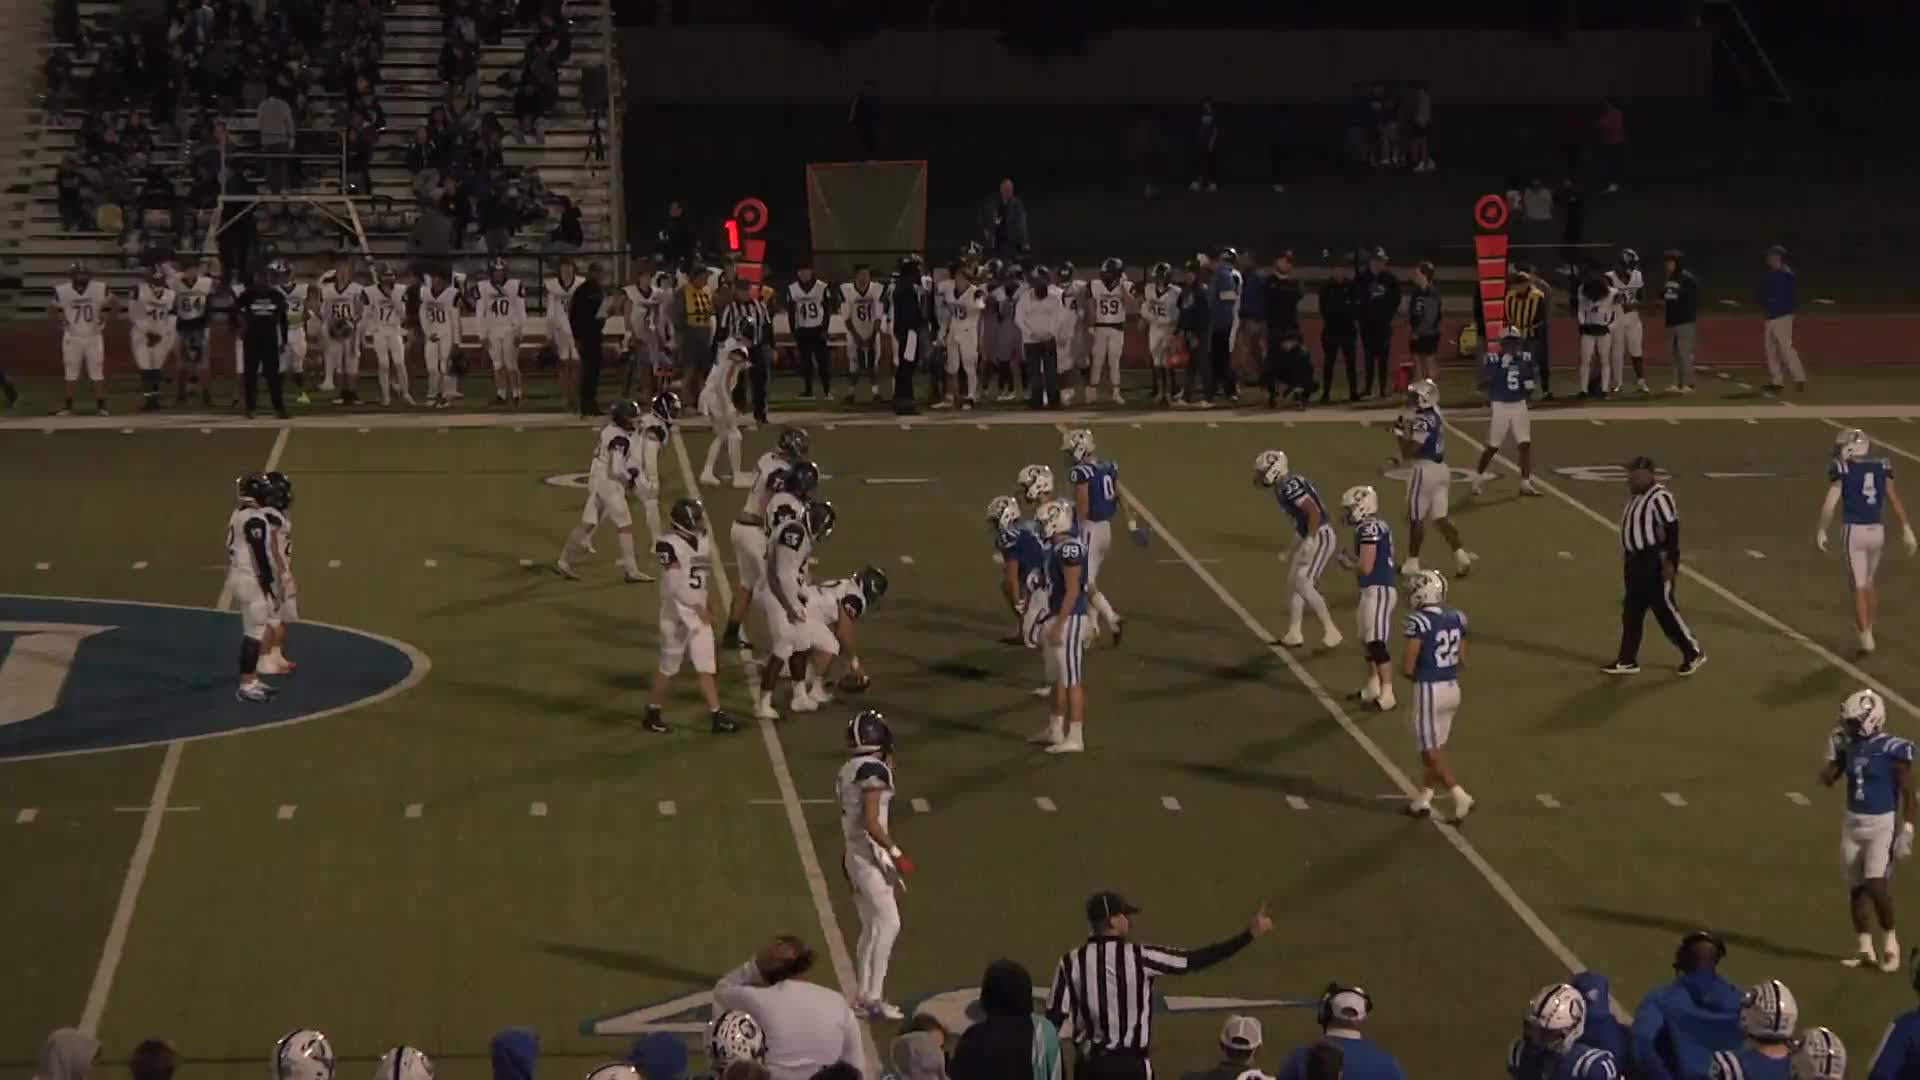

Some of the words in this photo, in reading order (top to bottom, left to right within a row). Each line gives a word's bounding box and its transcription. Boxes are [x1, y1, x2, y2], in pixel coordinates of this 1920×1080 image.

[723, 218, 740, 250] 1
[71, 305, 94, 322] 70
[1507, 370, 1520, 391] 5
[1103, 474, 1115, 500] 0
[1861, 471, 1878, 504] 4
[1061, 544, 1080, 559] 99
[690, 565, 703, 590] 5
[1434, 629, 1460, 668] 22
